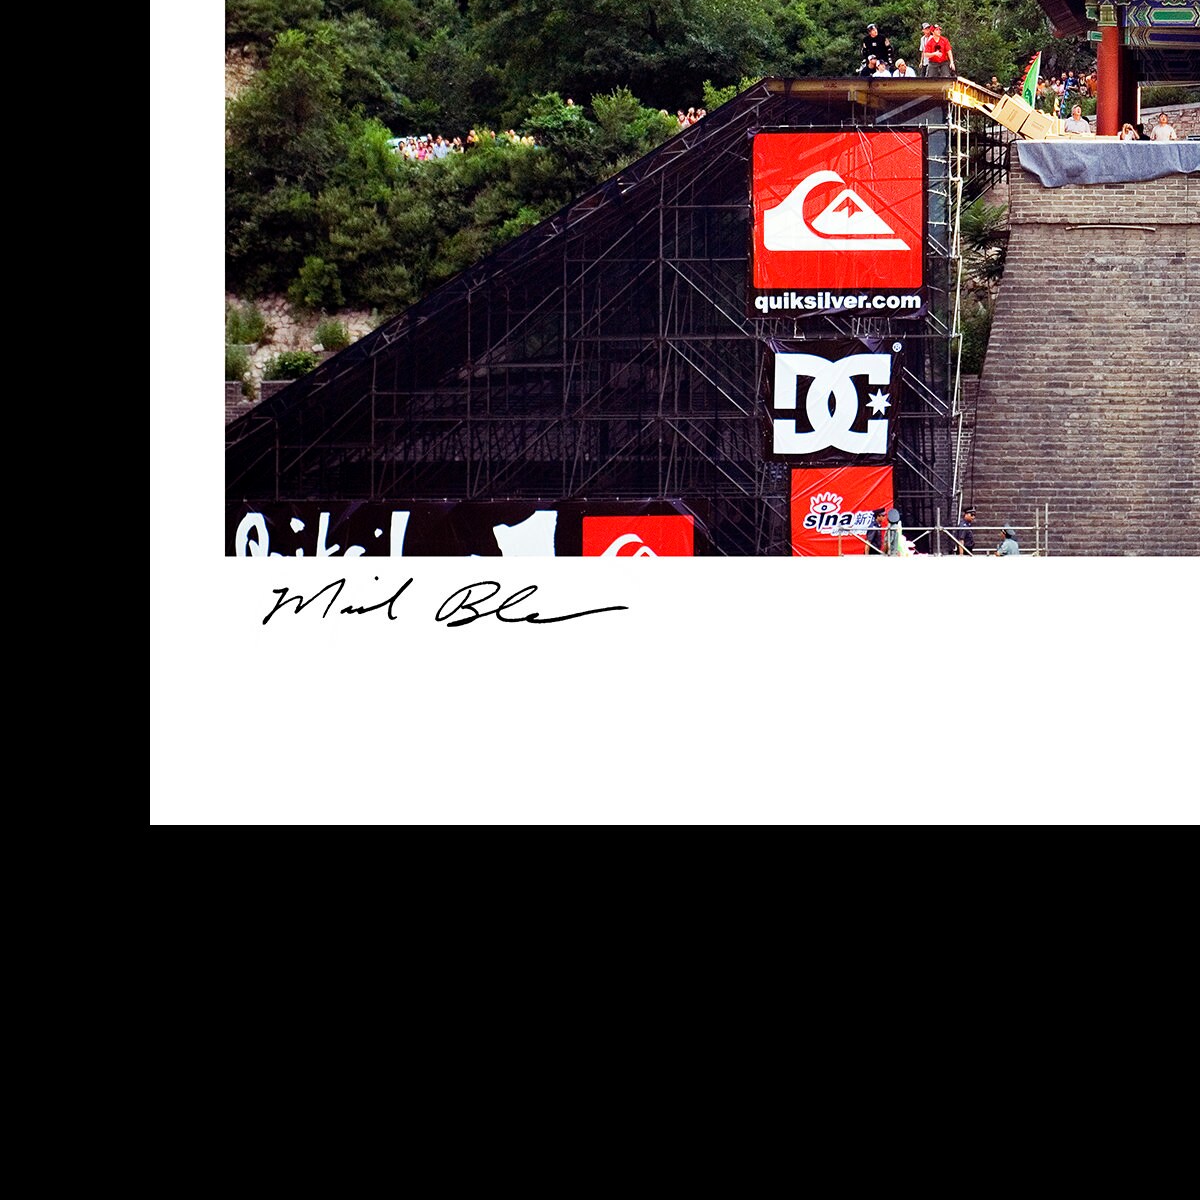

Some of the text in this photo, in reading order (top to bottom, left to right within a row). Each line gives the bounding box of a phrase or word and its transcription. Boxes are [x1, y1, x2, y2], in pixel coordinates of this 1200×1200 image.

[754, 291, 921, 313] quiksilver.com
[773, 352, 891, 454] DC
[804, 507, 853, 530] sina
